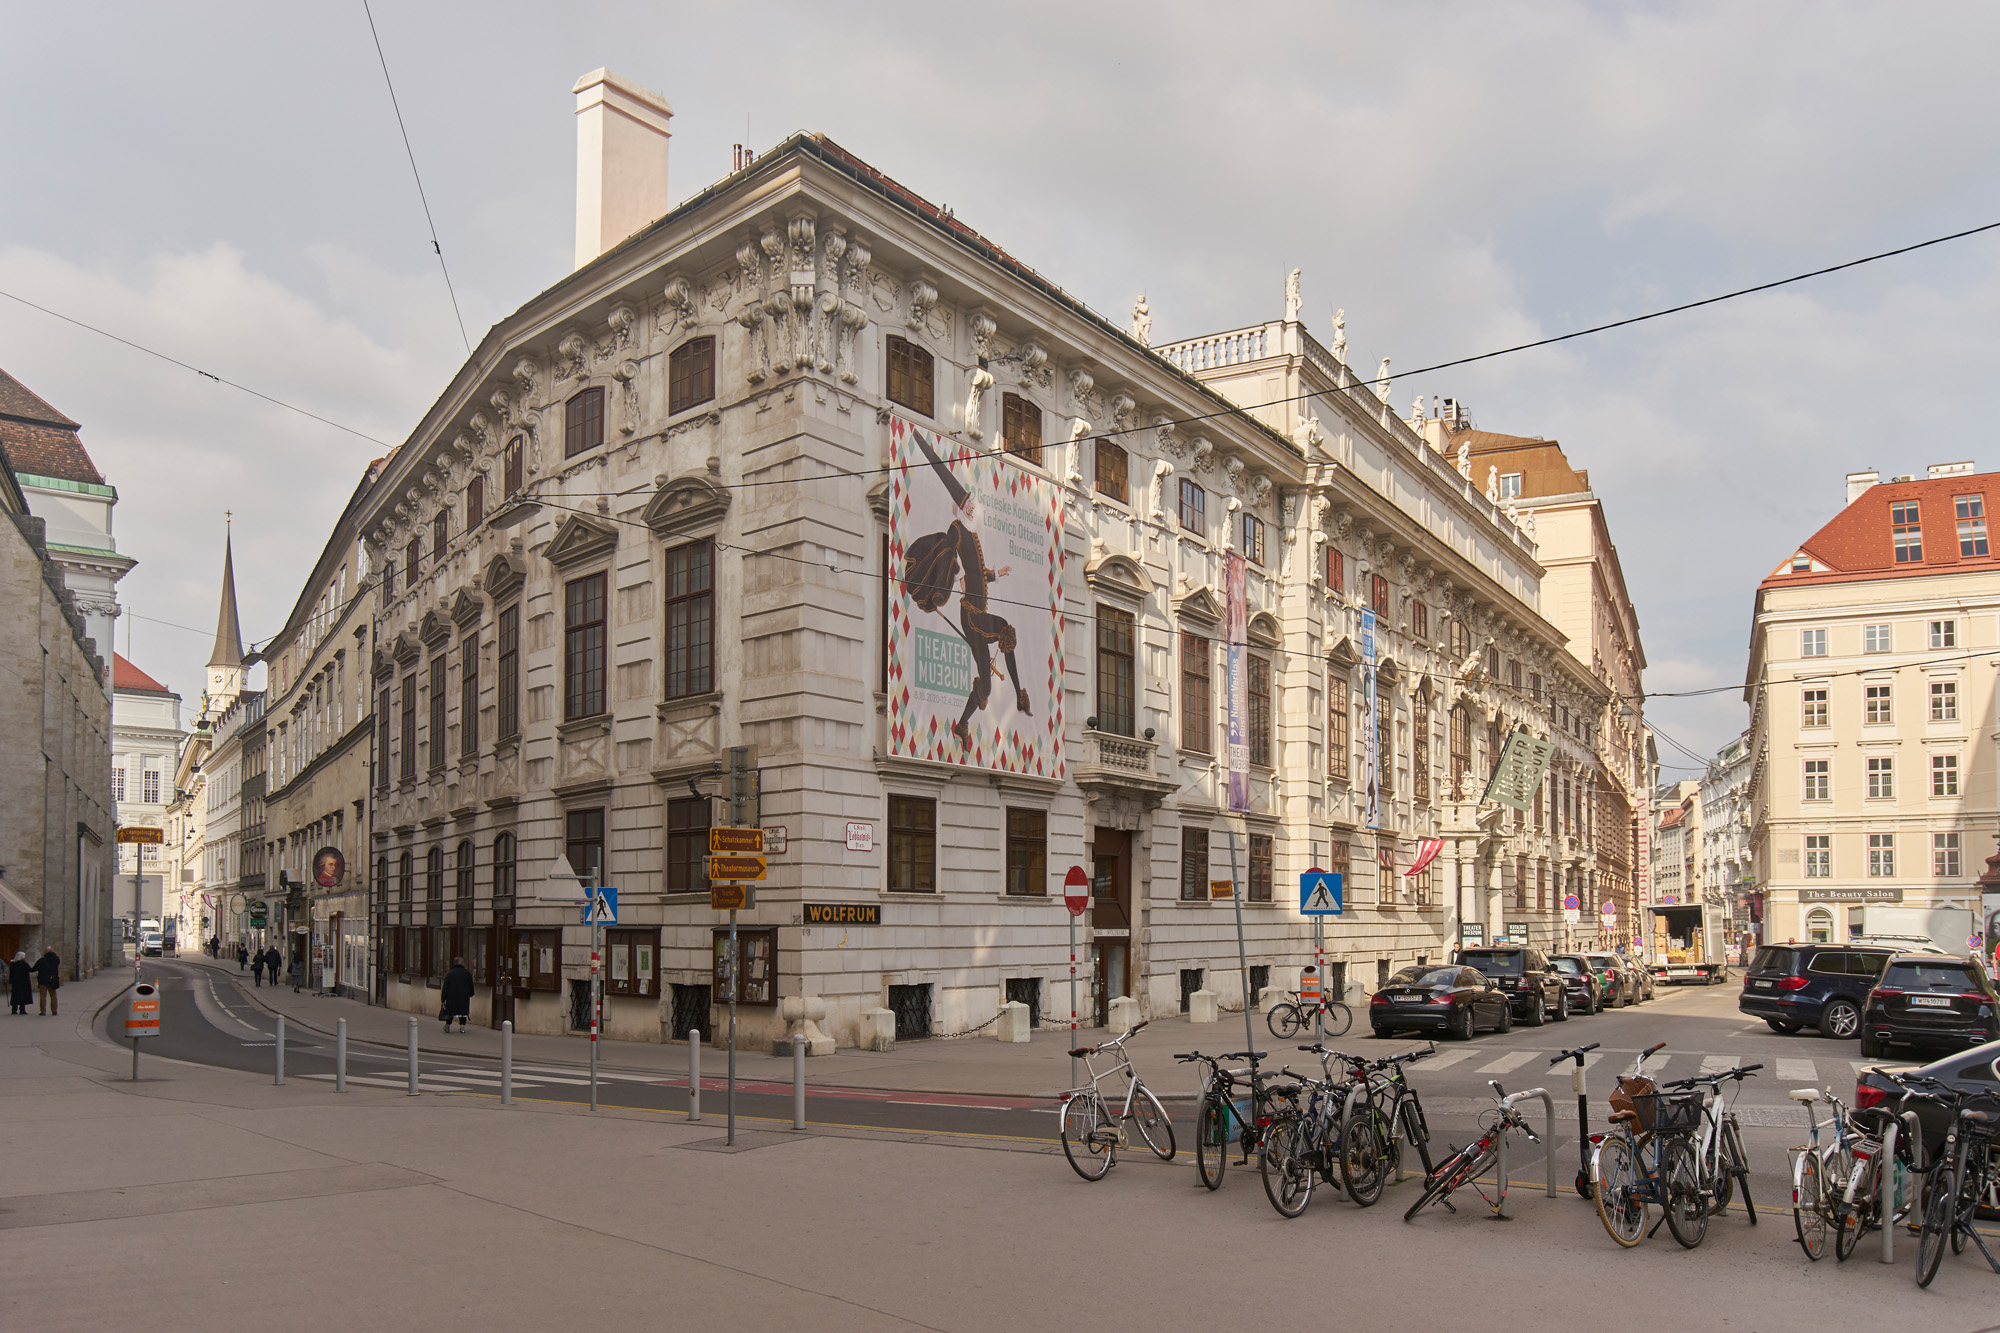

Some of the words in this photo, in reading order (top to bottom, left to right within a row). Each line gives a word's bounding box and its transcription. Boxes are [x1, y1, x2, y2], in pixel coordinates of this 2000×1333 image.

[977, 488, 1012, 516] Groteske
[1013, 501, 1044, 528] Komödie
[983, 510, 1017, 537] Lodovico
[1018, 524, 1044, 547] Ottavio
[1009, 539, 1044, 566] Burnacini
[917, 634, 968, 667] THEATER
[722, 835, 754, 844] Schatzkammer
[1637, 798, 1648, 902] DOROTHEUM
[720, 864, 760, 872] Theatermuseum
[1830, 890, 1863, 899] Beauty
[1867, 890, 1894, 898] Salon
[809, 906, 876, 922] WOLFRUM
